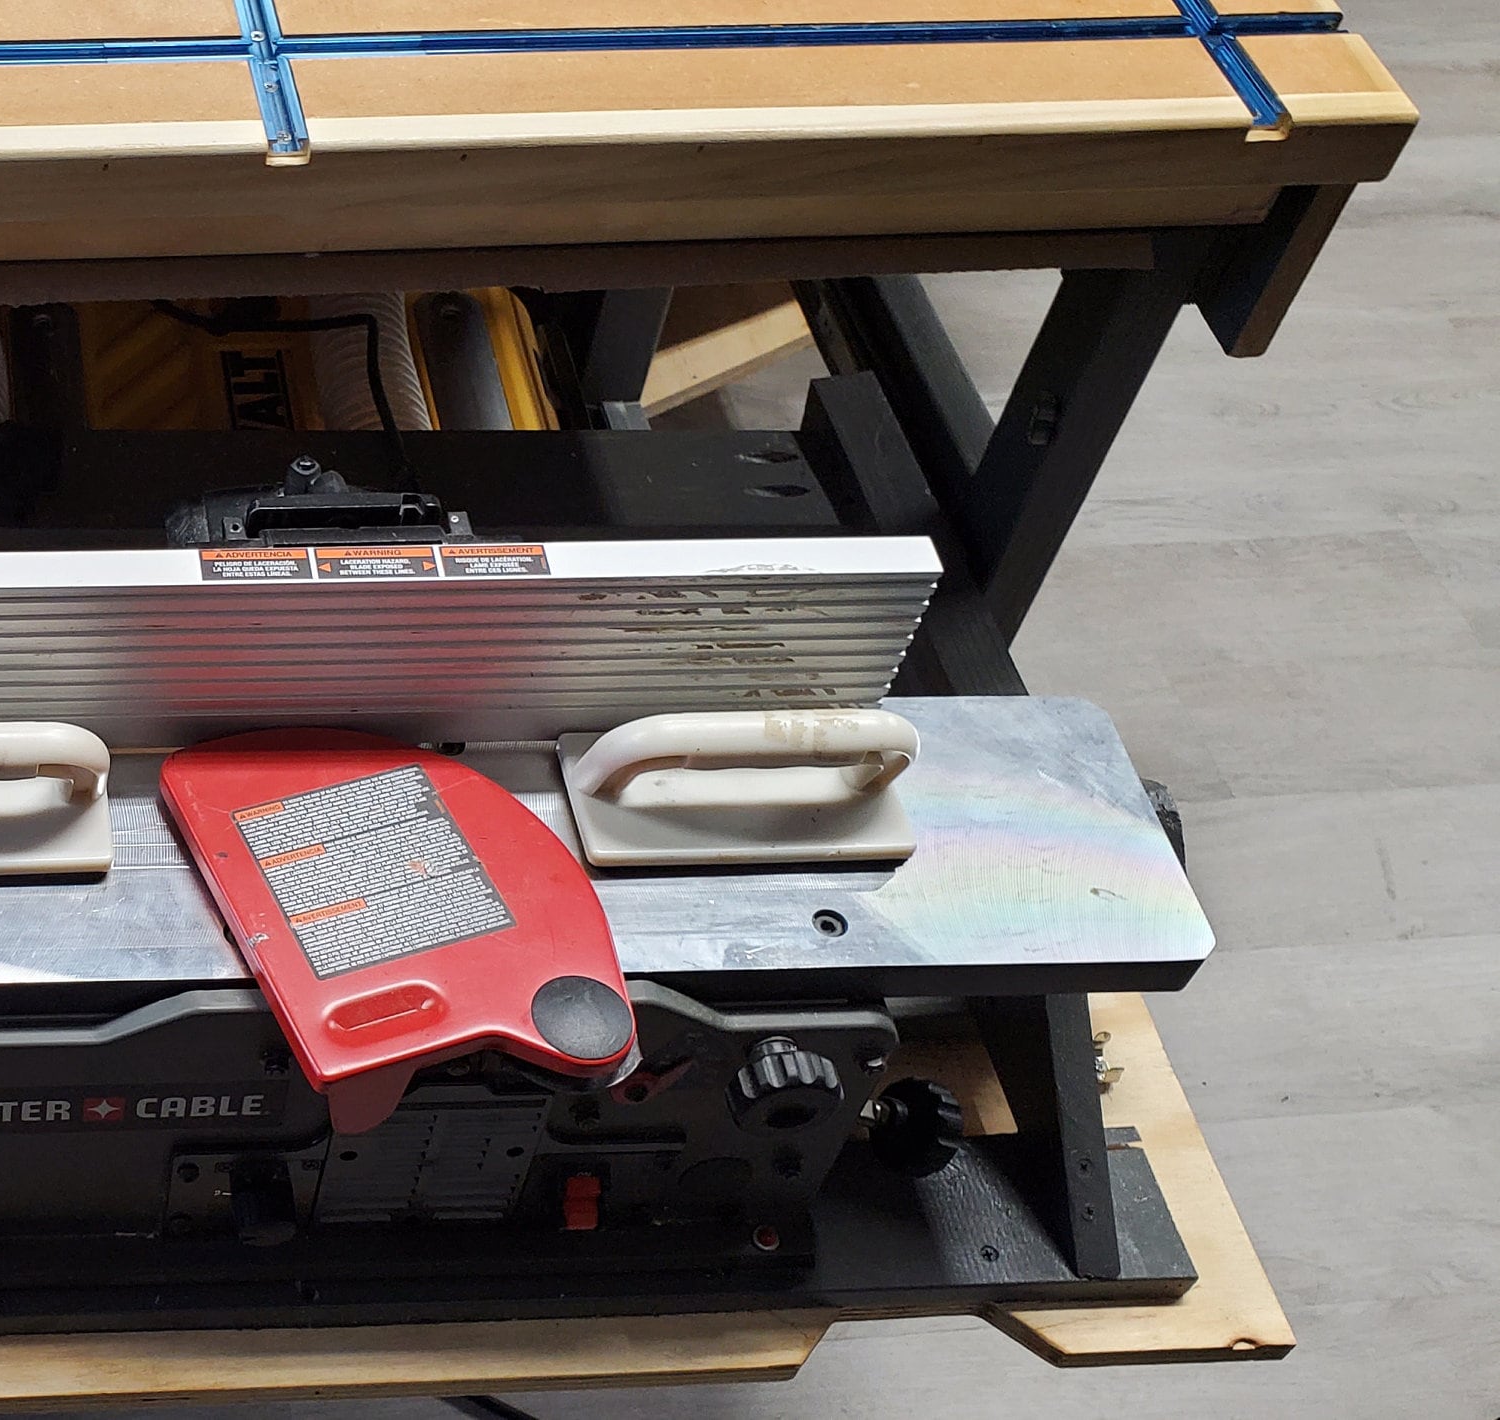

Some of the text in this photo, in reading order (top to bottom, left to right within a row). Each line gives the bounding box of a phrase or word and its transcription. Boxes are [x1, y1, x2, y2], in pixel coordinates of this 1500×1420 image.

[458, 547, 534, 555] AVERTISSEMENT
[245, 804, 280, 817] WARNING
[272, 847, 322, 865] ADVERTENCIA
[303, 901, 362, 921] AVERTISSEMENT
[135, 1094, 265, 1119] CABLE
